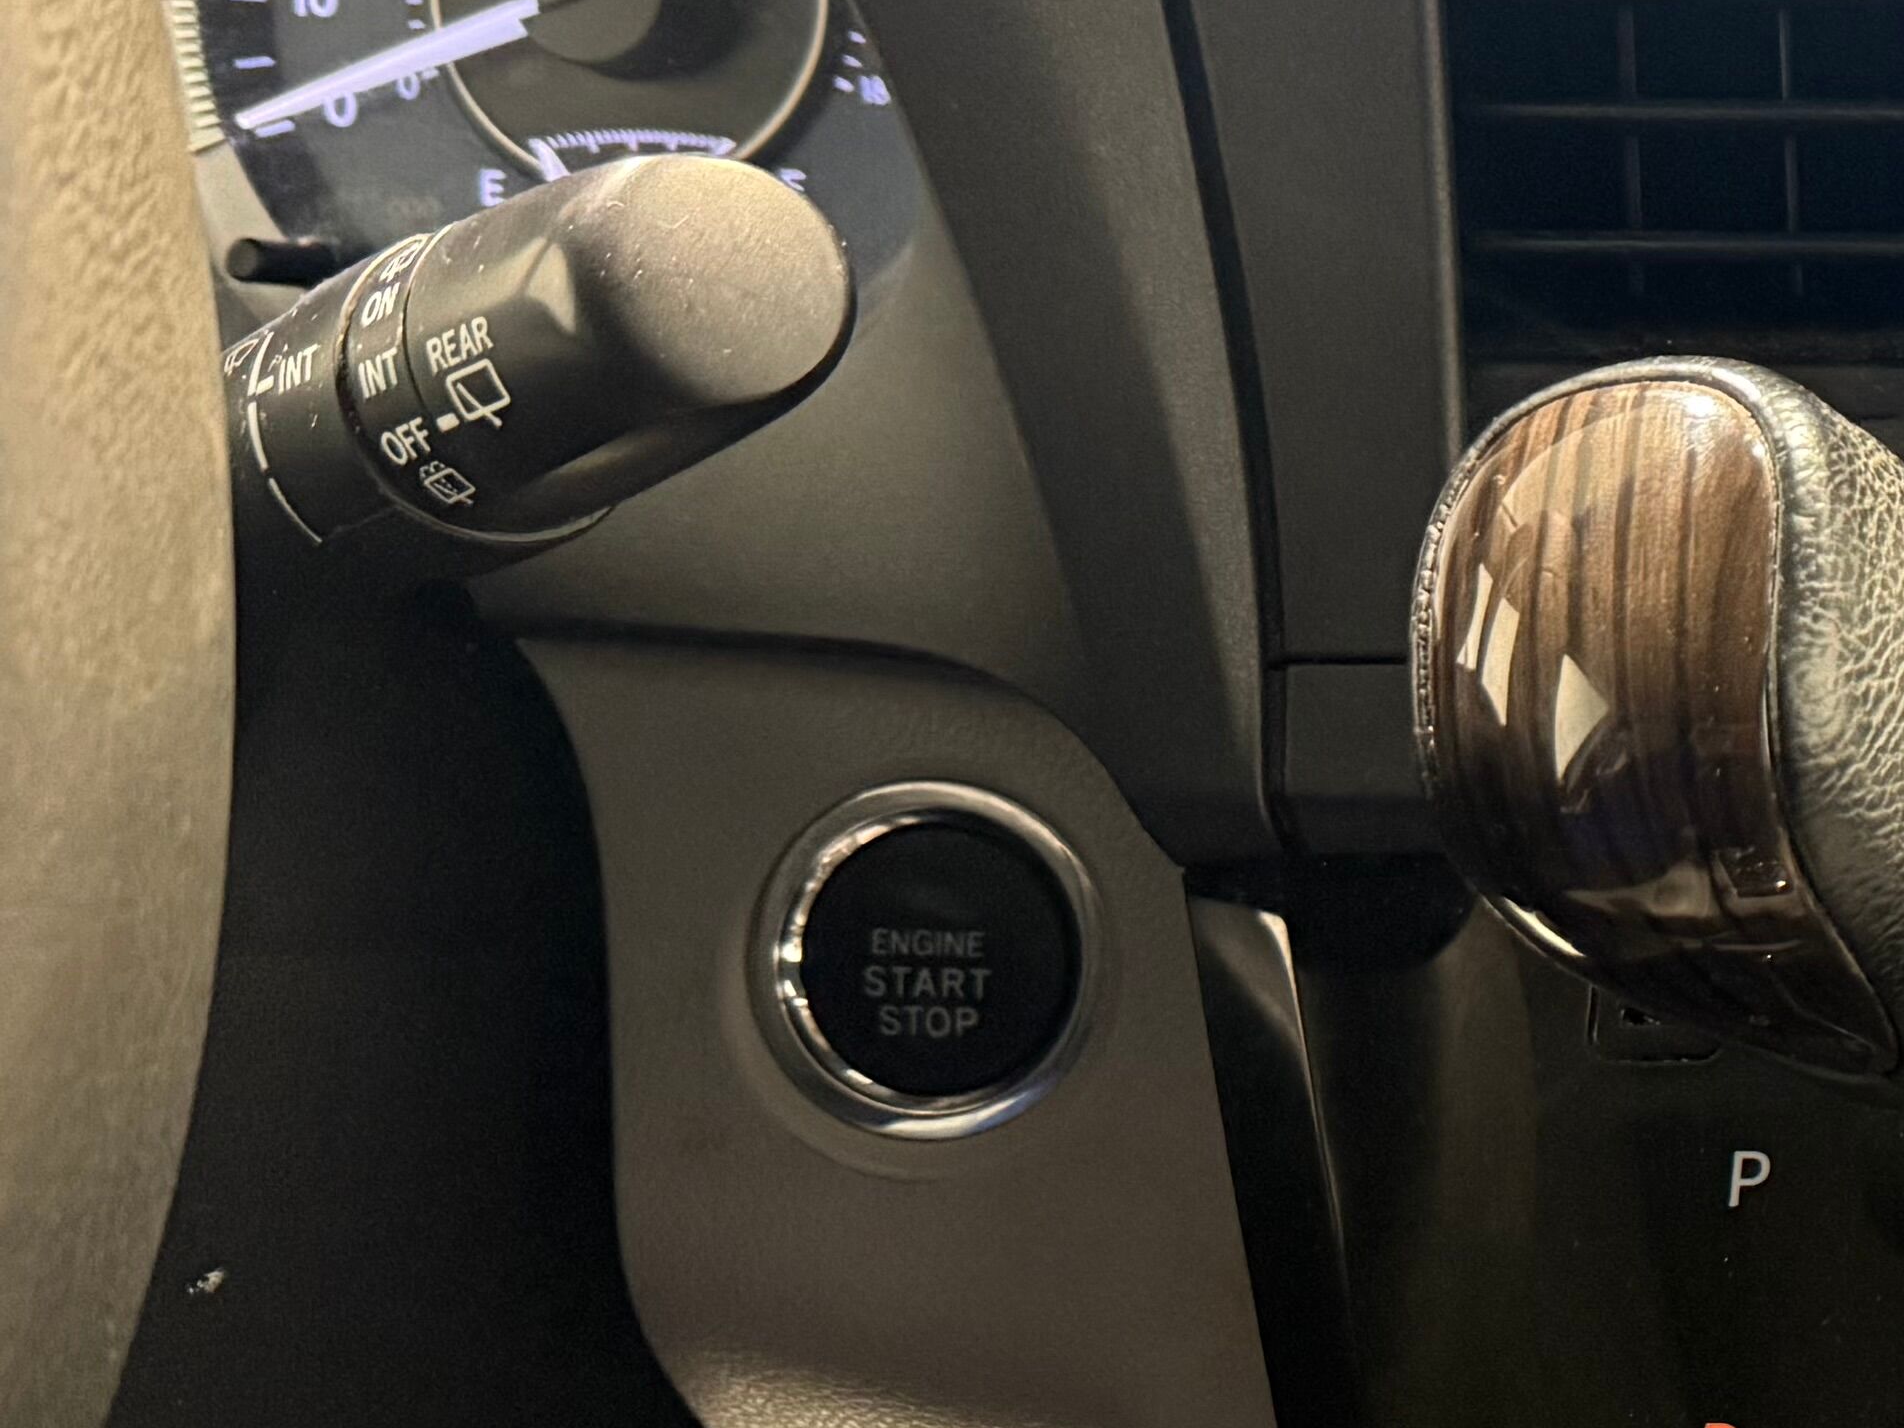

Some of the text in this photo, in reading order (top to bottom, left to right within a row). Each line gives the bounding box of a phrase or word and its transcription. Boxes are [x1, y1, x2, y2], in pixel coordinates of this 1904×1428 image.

[323, 90, 357, 128] 0
[479, 169, 506, 207] E
[361, 282, 400, 328] ON
[278, 343, 321, 395] INT
[426, 316, 494, 376] REAR
[358, 348, 398, 399] INT
[380, 417, 432, 465] OFF
[871, 928, 985, 958] ENGINE
[862, 966, 992, 1000] START
[879, 1005, 979, 1038] STOP
[1728, 1151, 1771, 1208] P
